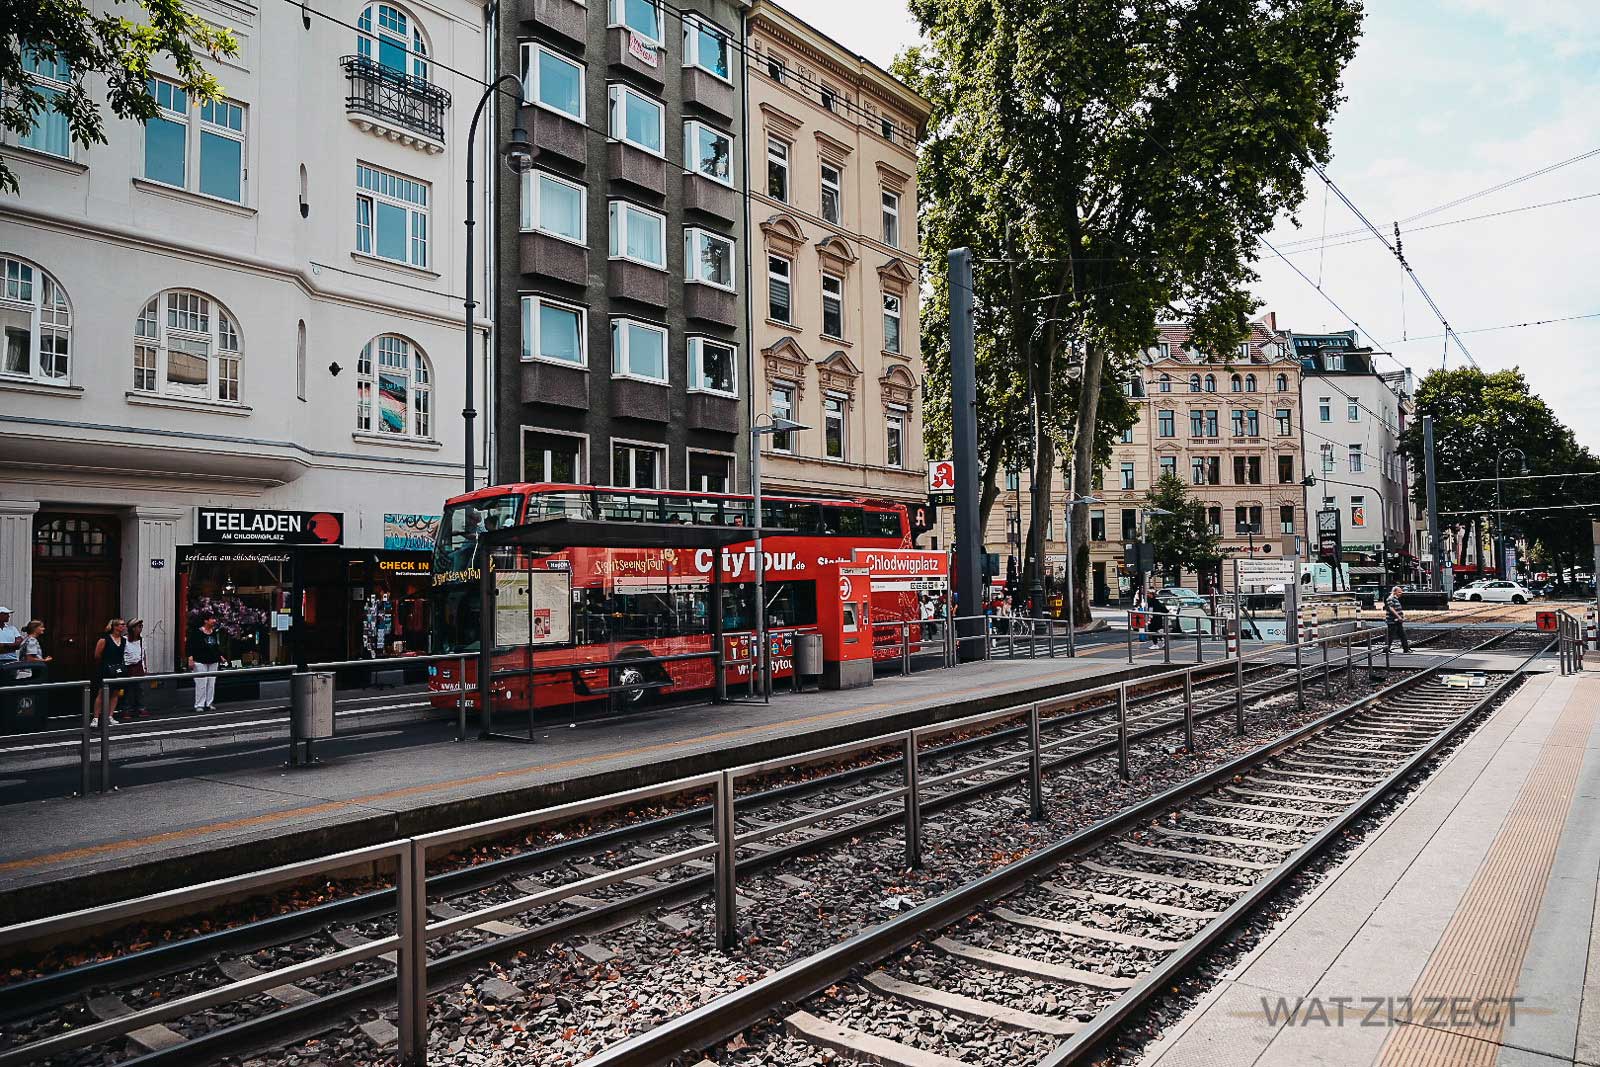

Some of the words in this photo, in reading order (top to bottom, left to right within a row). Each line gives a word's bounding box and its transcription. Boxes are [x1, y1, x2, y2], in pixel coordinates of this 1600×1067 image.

[202, 512, 301, 532] TEELADEN
[221, 532, 232, 540] AM
[233, 533, 285, 541] CHLODWIGPLATZ
[379, 561, 415, 570] CHECK
[418, 562, 430, 570] IN
[866, 554, 939, 574] Chlodwigplatz
